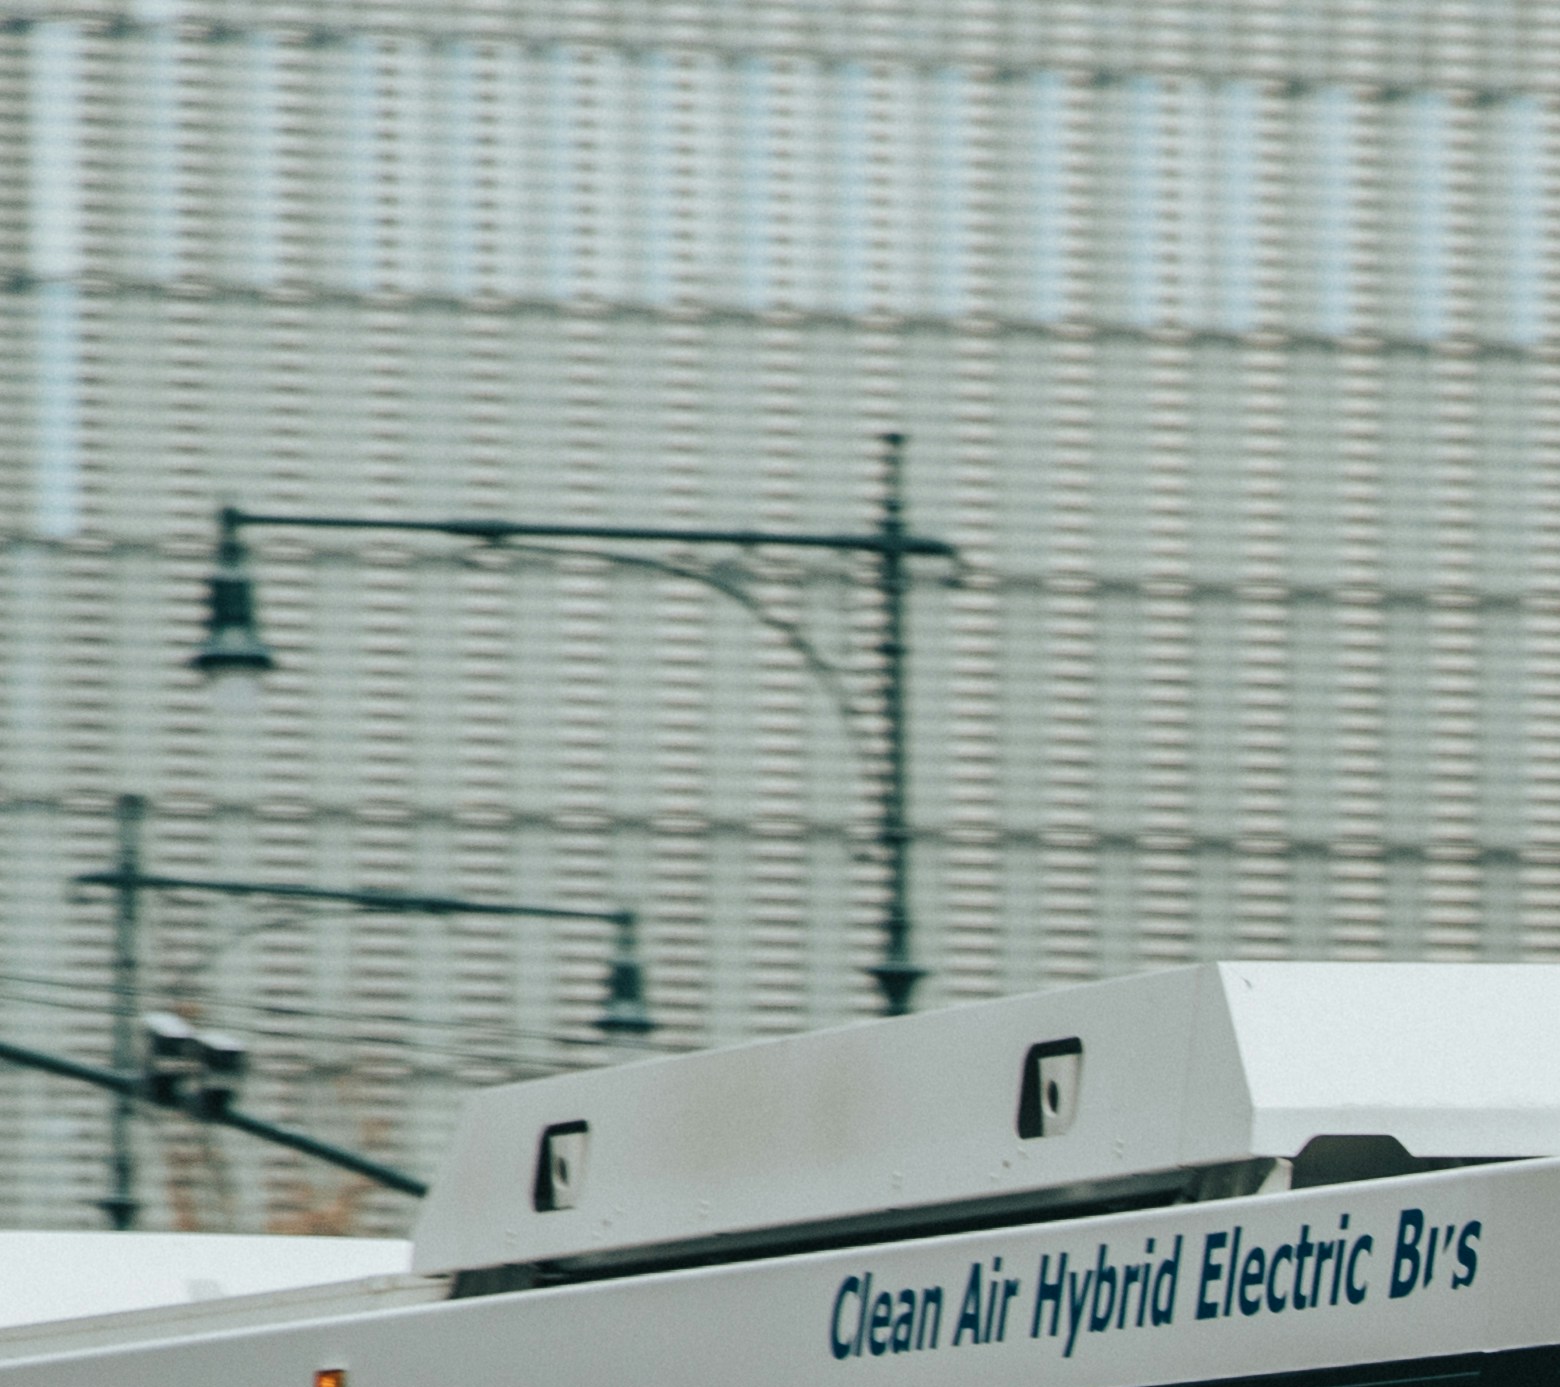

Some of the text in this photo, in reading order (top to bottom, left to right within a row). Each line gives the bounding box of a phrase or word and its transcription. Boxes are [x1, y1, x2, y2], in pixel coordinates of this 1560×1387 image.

[829, 1270, 943, 1361] Clean
[950, 1256, 1022, 1348] Air
[1030, 1233, 1185, 1359] Hybrid
[1194, 1213, 1375, 1322] Electric
